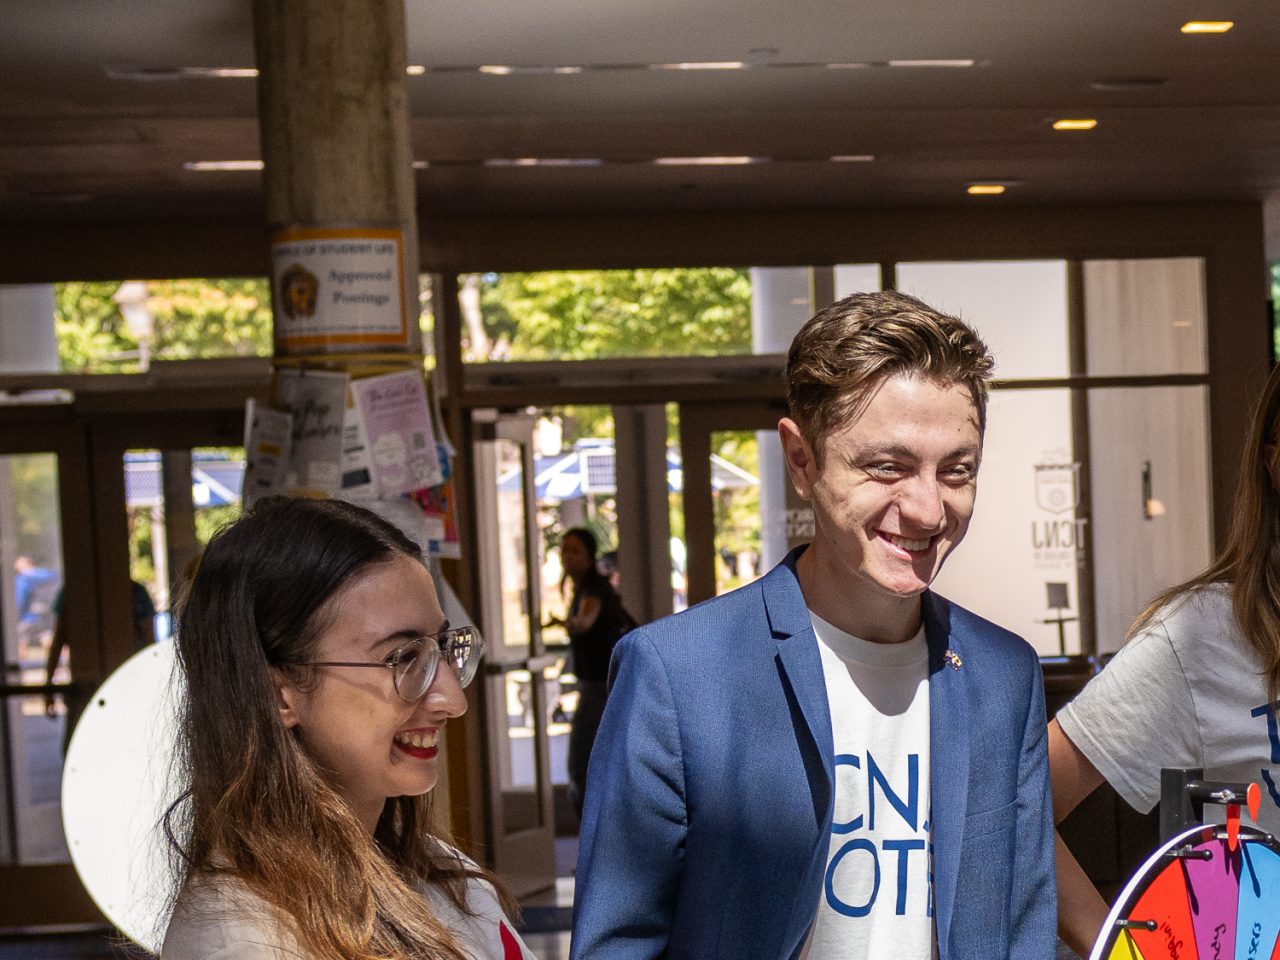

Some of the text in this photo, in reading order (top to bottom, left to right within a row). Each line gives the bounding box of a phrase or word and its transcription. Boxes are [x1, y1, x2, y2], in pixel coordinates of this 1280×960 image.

[328, 268, 392, 284] Approved
[332, 290, 390, 306] Postings
[832, 749, 931, 833] CN
